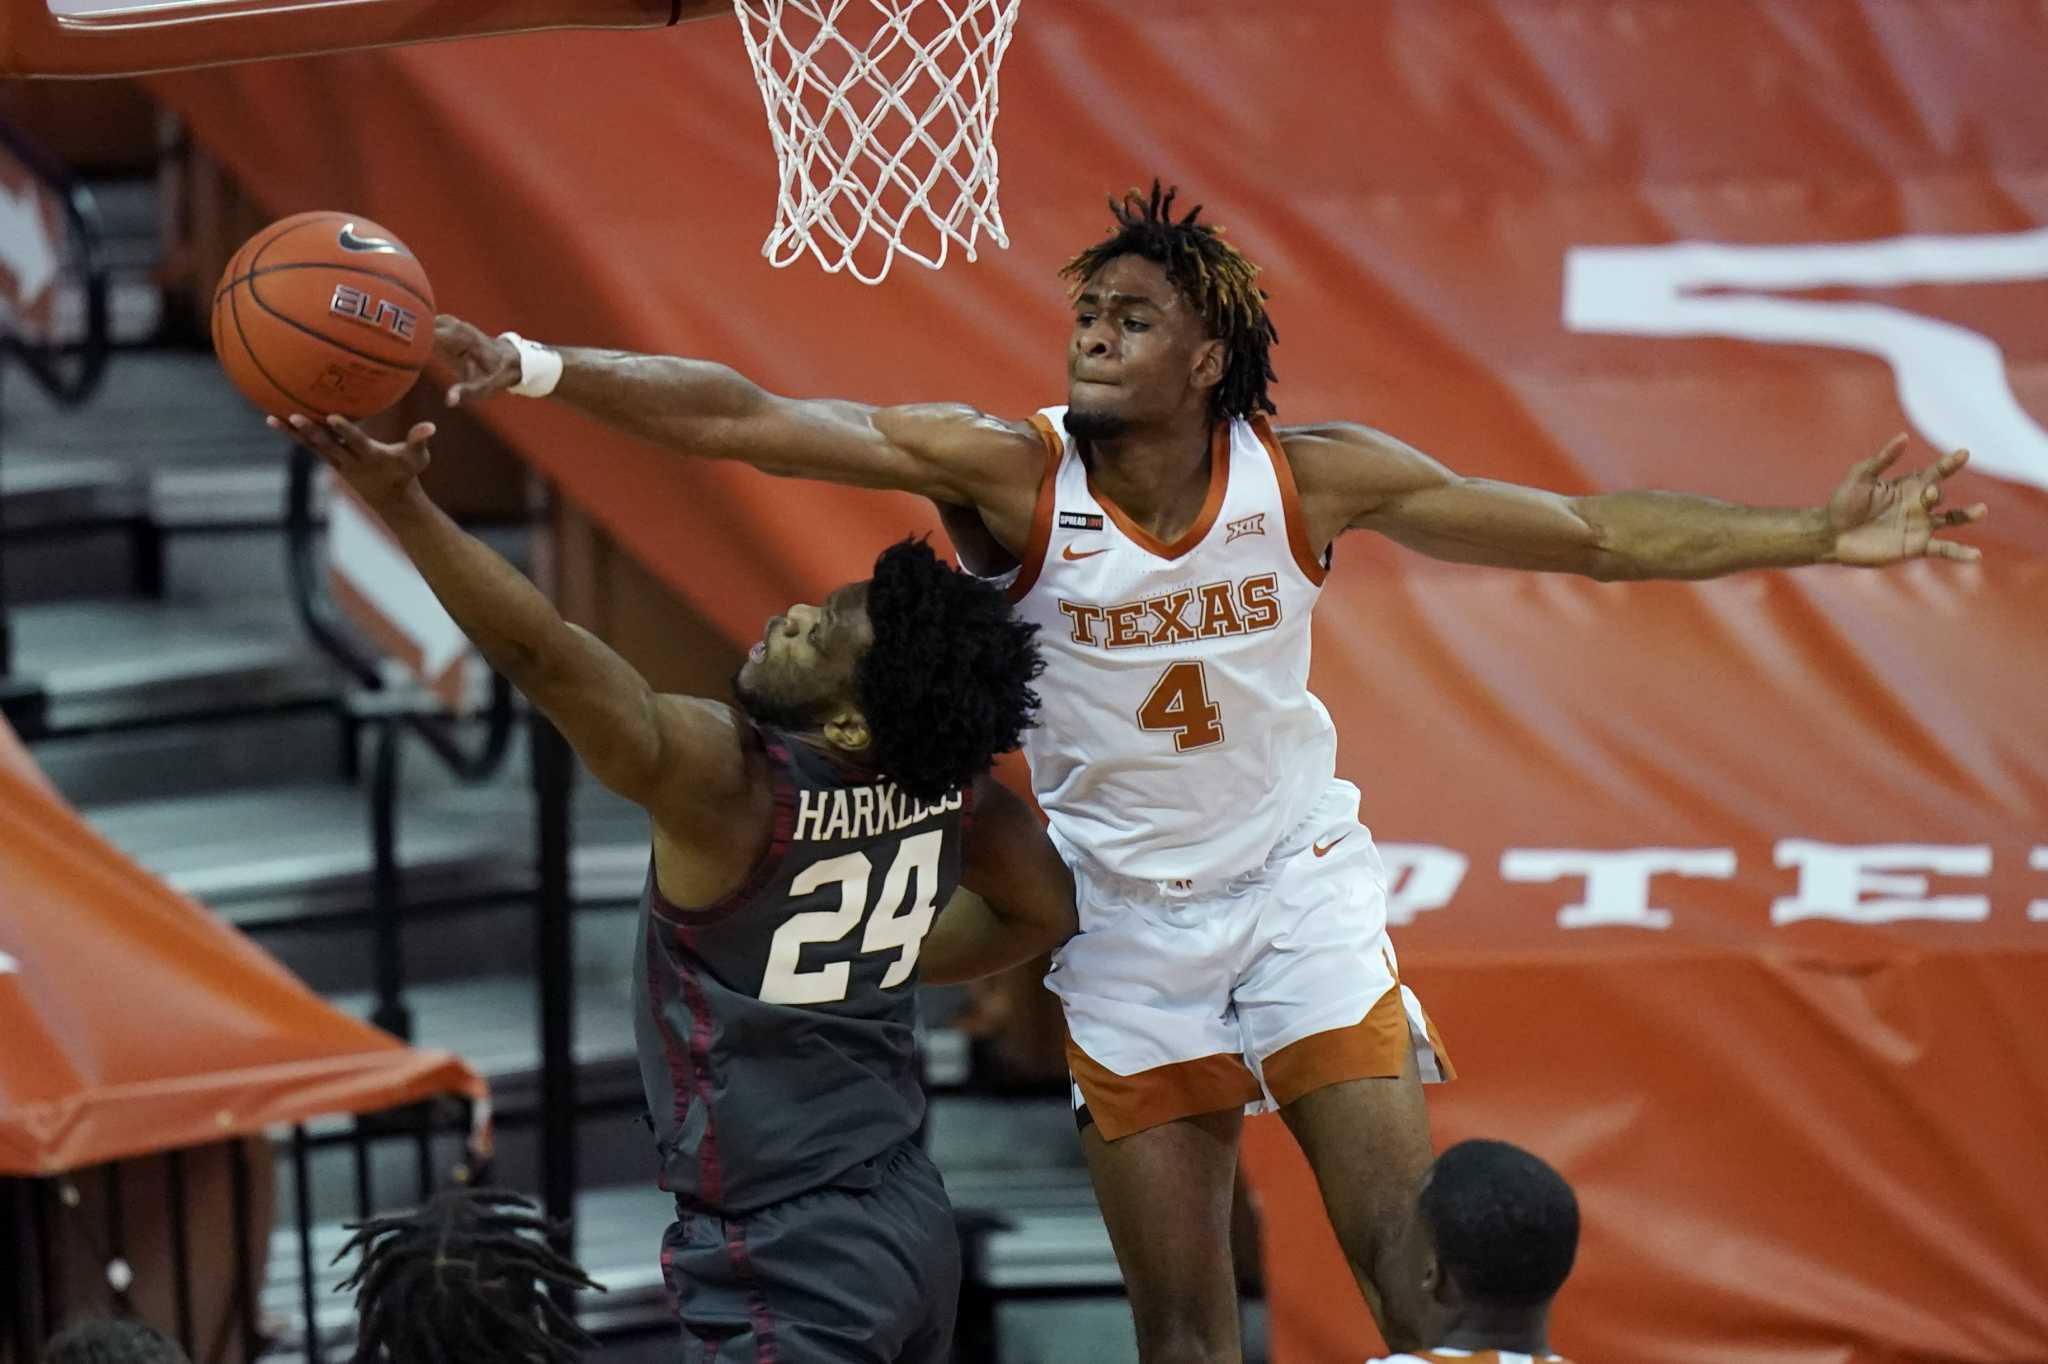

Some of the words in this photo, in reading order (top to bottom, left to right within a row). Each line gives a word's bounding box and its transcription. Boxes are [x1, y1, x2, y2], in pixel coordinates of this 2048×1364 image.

[329, 283, 417, 346] ELITE
[1058, 571, 1283, 650] TEXAS
[1136, 660, 1225, 752] 4
[793, 781, 963, 841] HARKL
[758, 828, 943, 1005] 24
